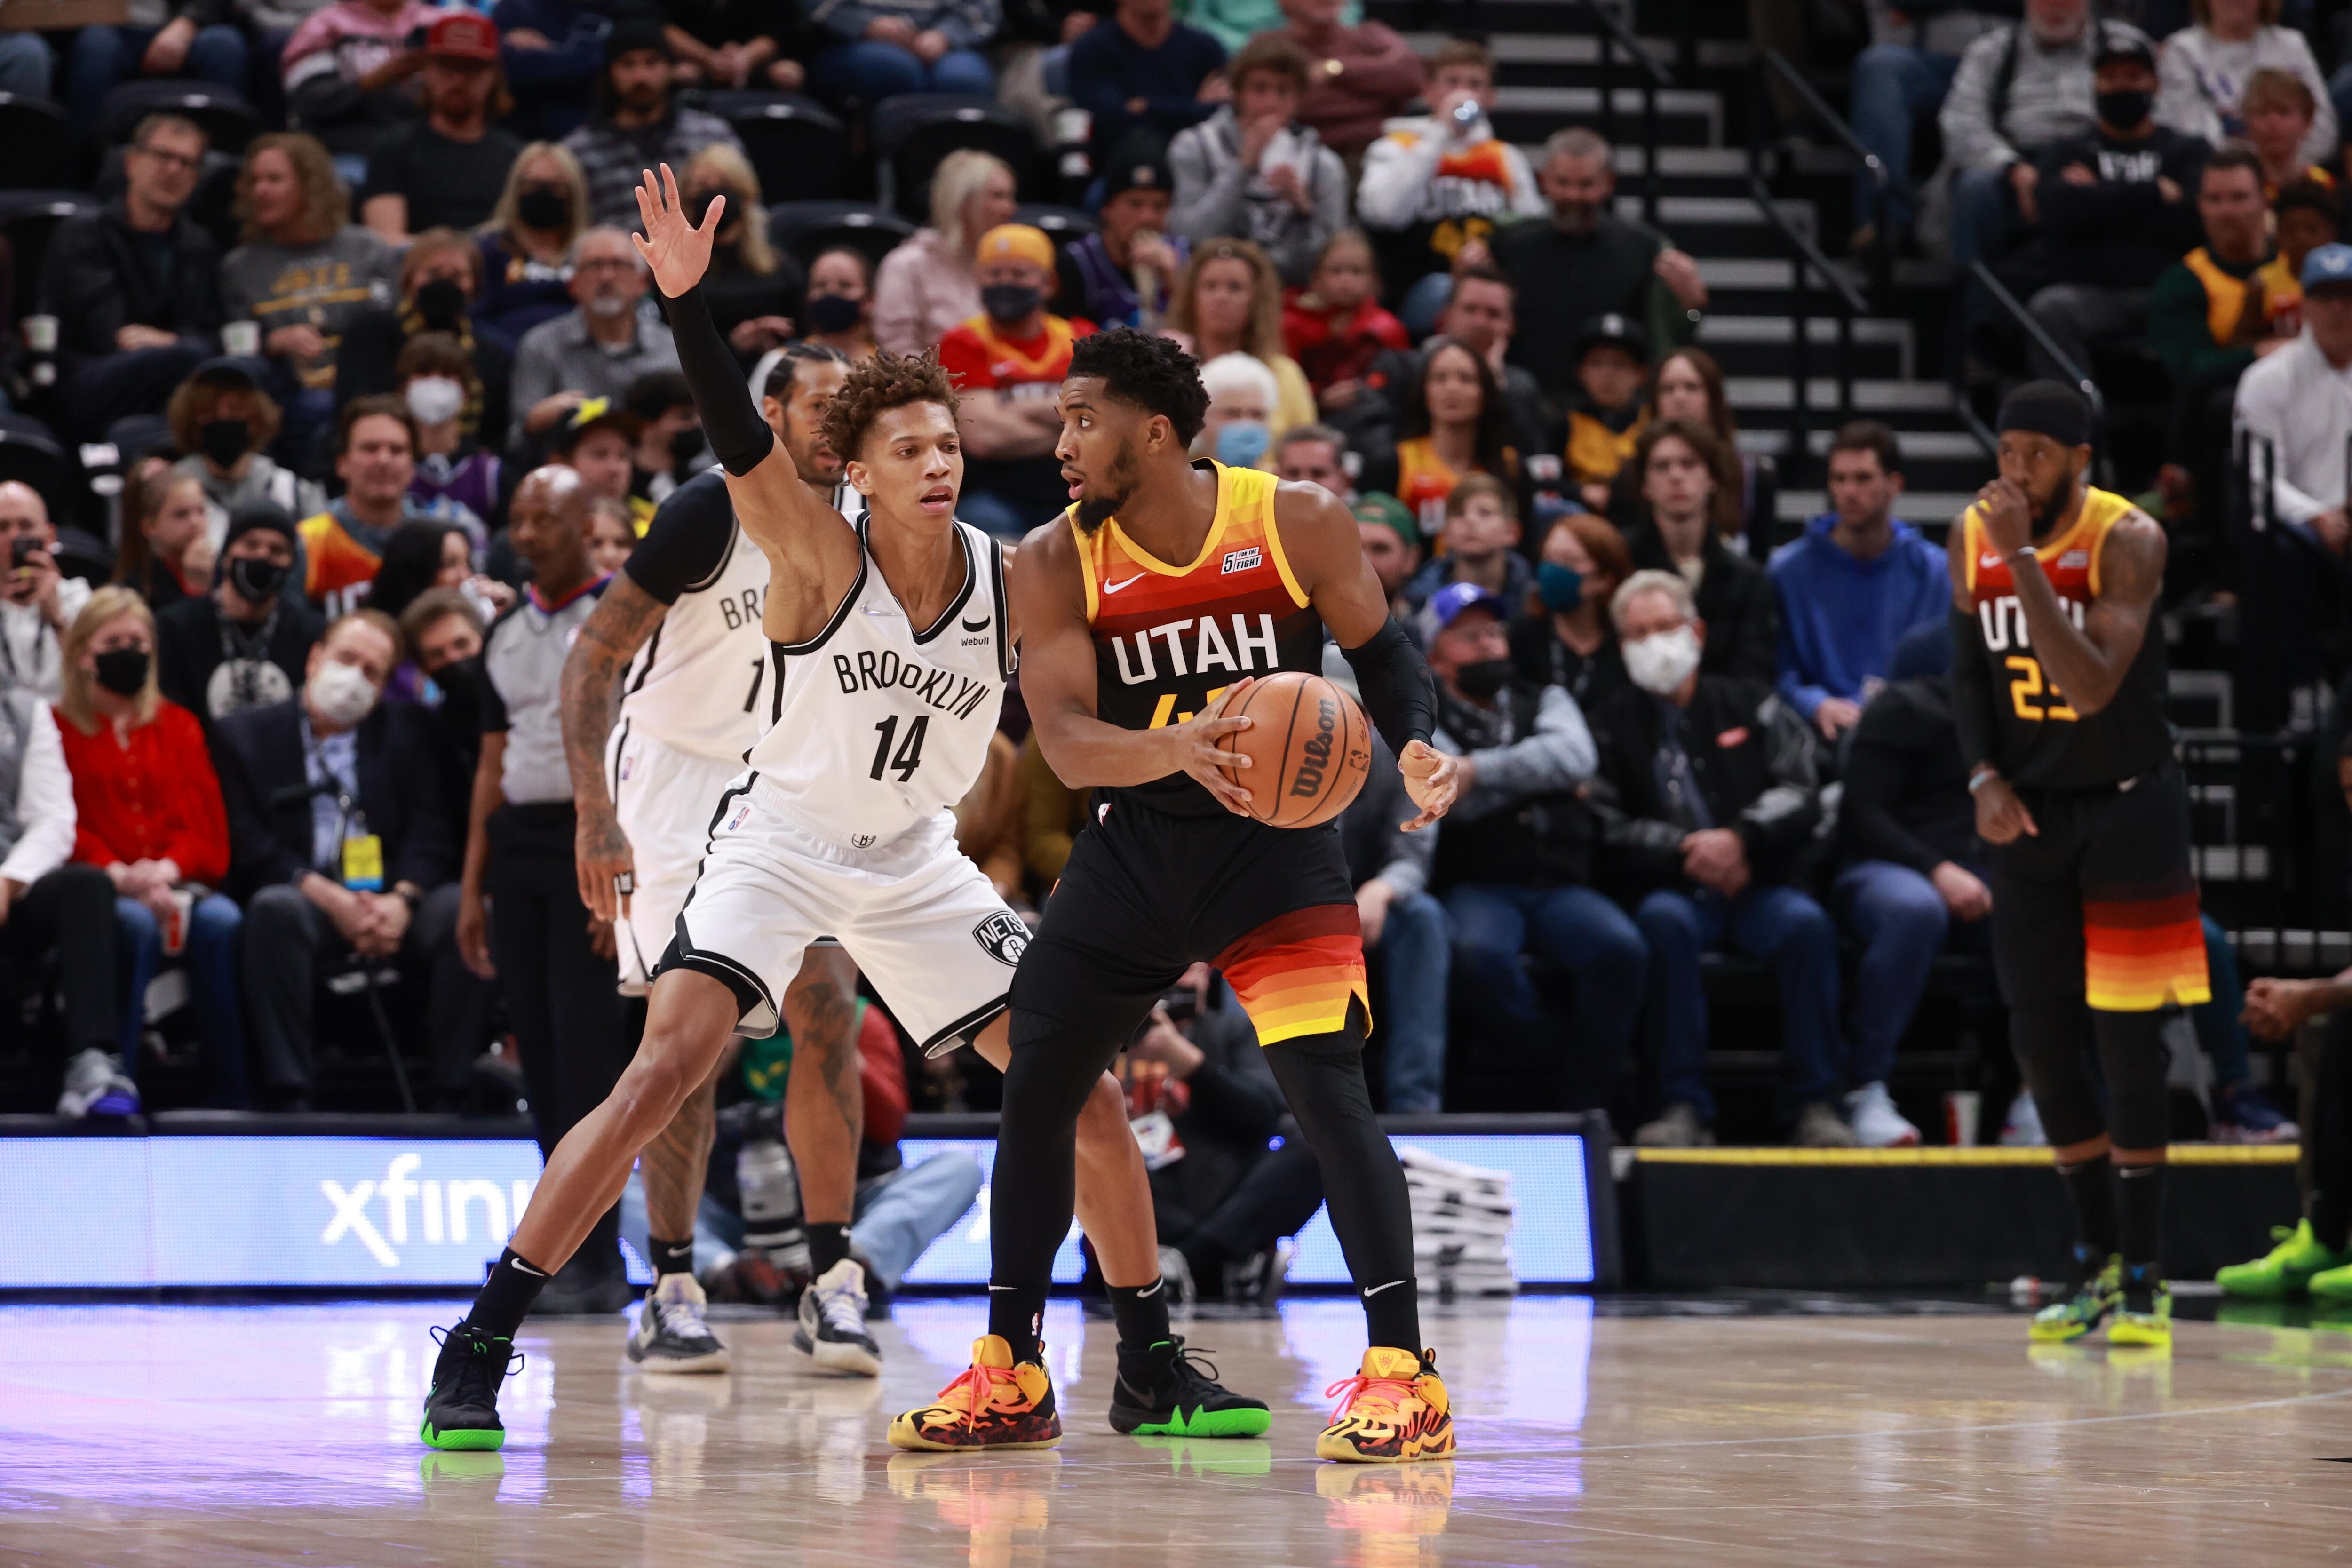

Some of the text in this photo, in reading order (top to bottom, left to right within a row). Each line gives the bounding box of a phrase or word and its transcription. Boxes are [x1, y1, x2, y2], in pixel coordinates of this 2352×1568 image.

[1224, 554, 1234, 572] 5
[1237, 557, 1260, 569] FIGHT
[961, 637, 989, 646] Webull
[1112, 614, 1279, 685] UTAH
[833, 650, 990, 720] BROOKLYN
[869, 715, 930, 782] 14
[1289, 699, 1336, 798] Wilson
[979, 914, 1025, 949] NETS
